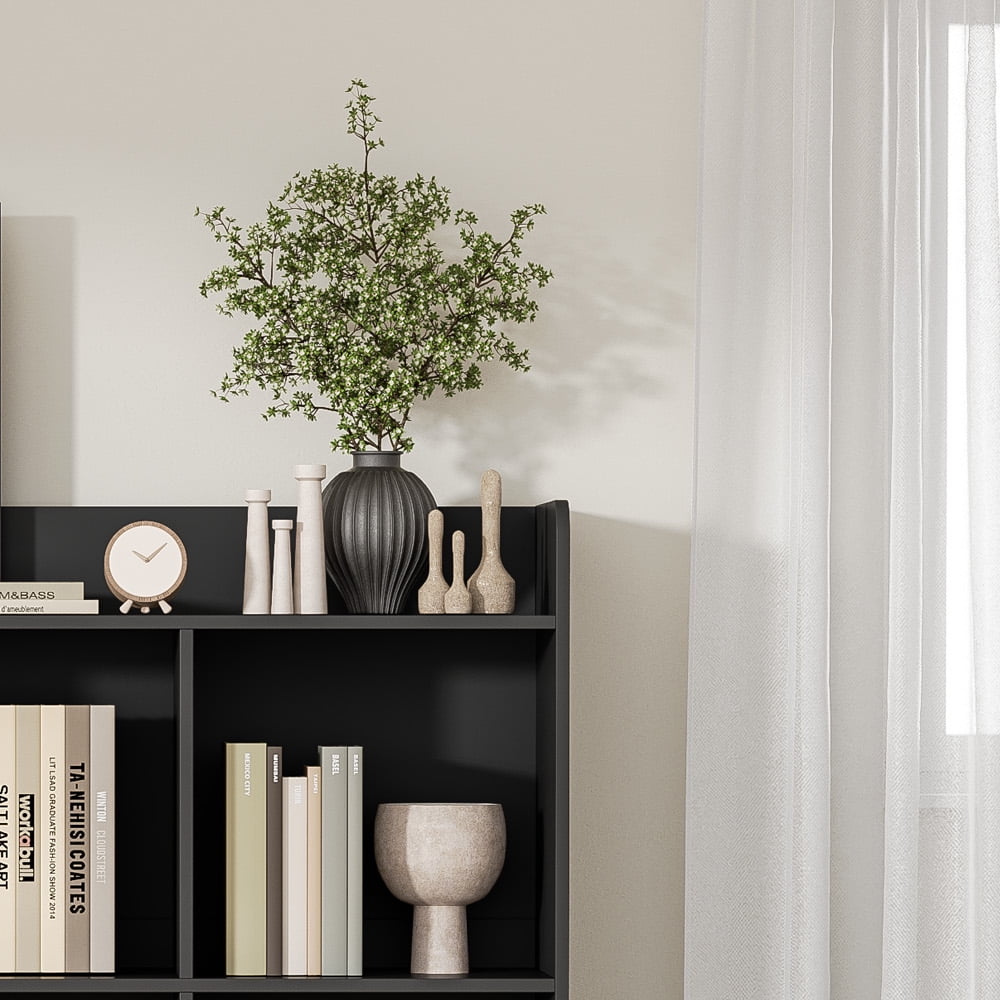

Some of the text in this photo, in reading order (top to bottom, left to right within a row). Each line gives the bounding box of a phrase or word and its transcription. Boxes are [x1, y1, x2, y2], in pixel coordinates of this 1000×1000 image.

[1, 606, 45, 614] d'ameublement
[332, 755, 340, 775] BASEL
[96, 792, 107, 823] WINTON
[19, 795, 34, 880] workabull.
[70, 763, 85, 913] TA-NEHISI COATES
